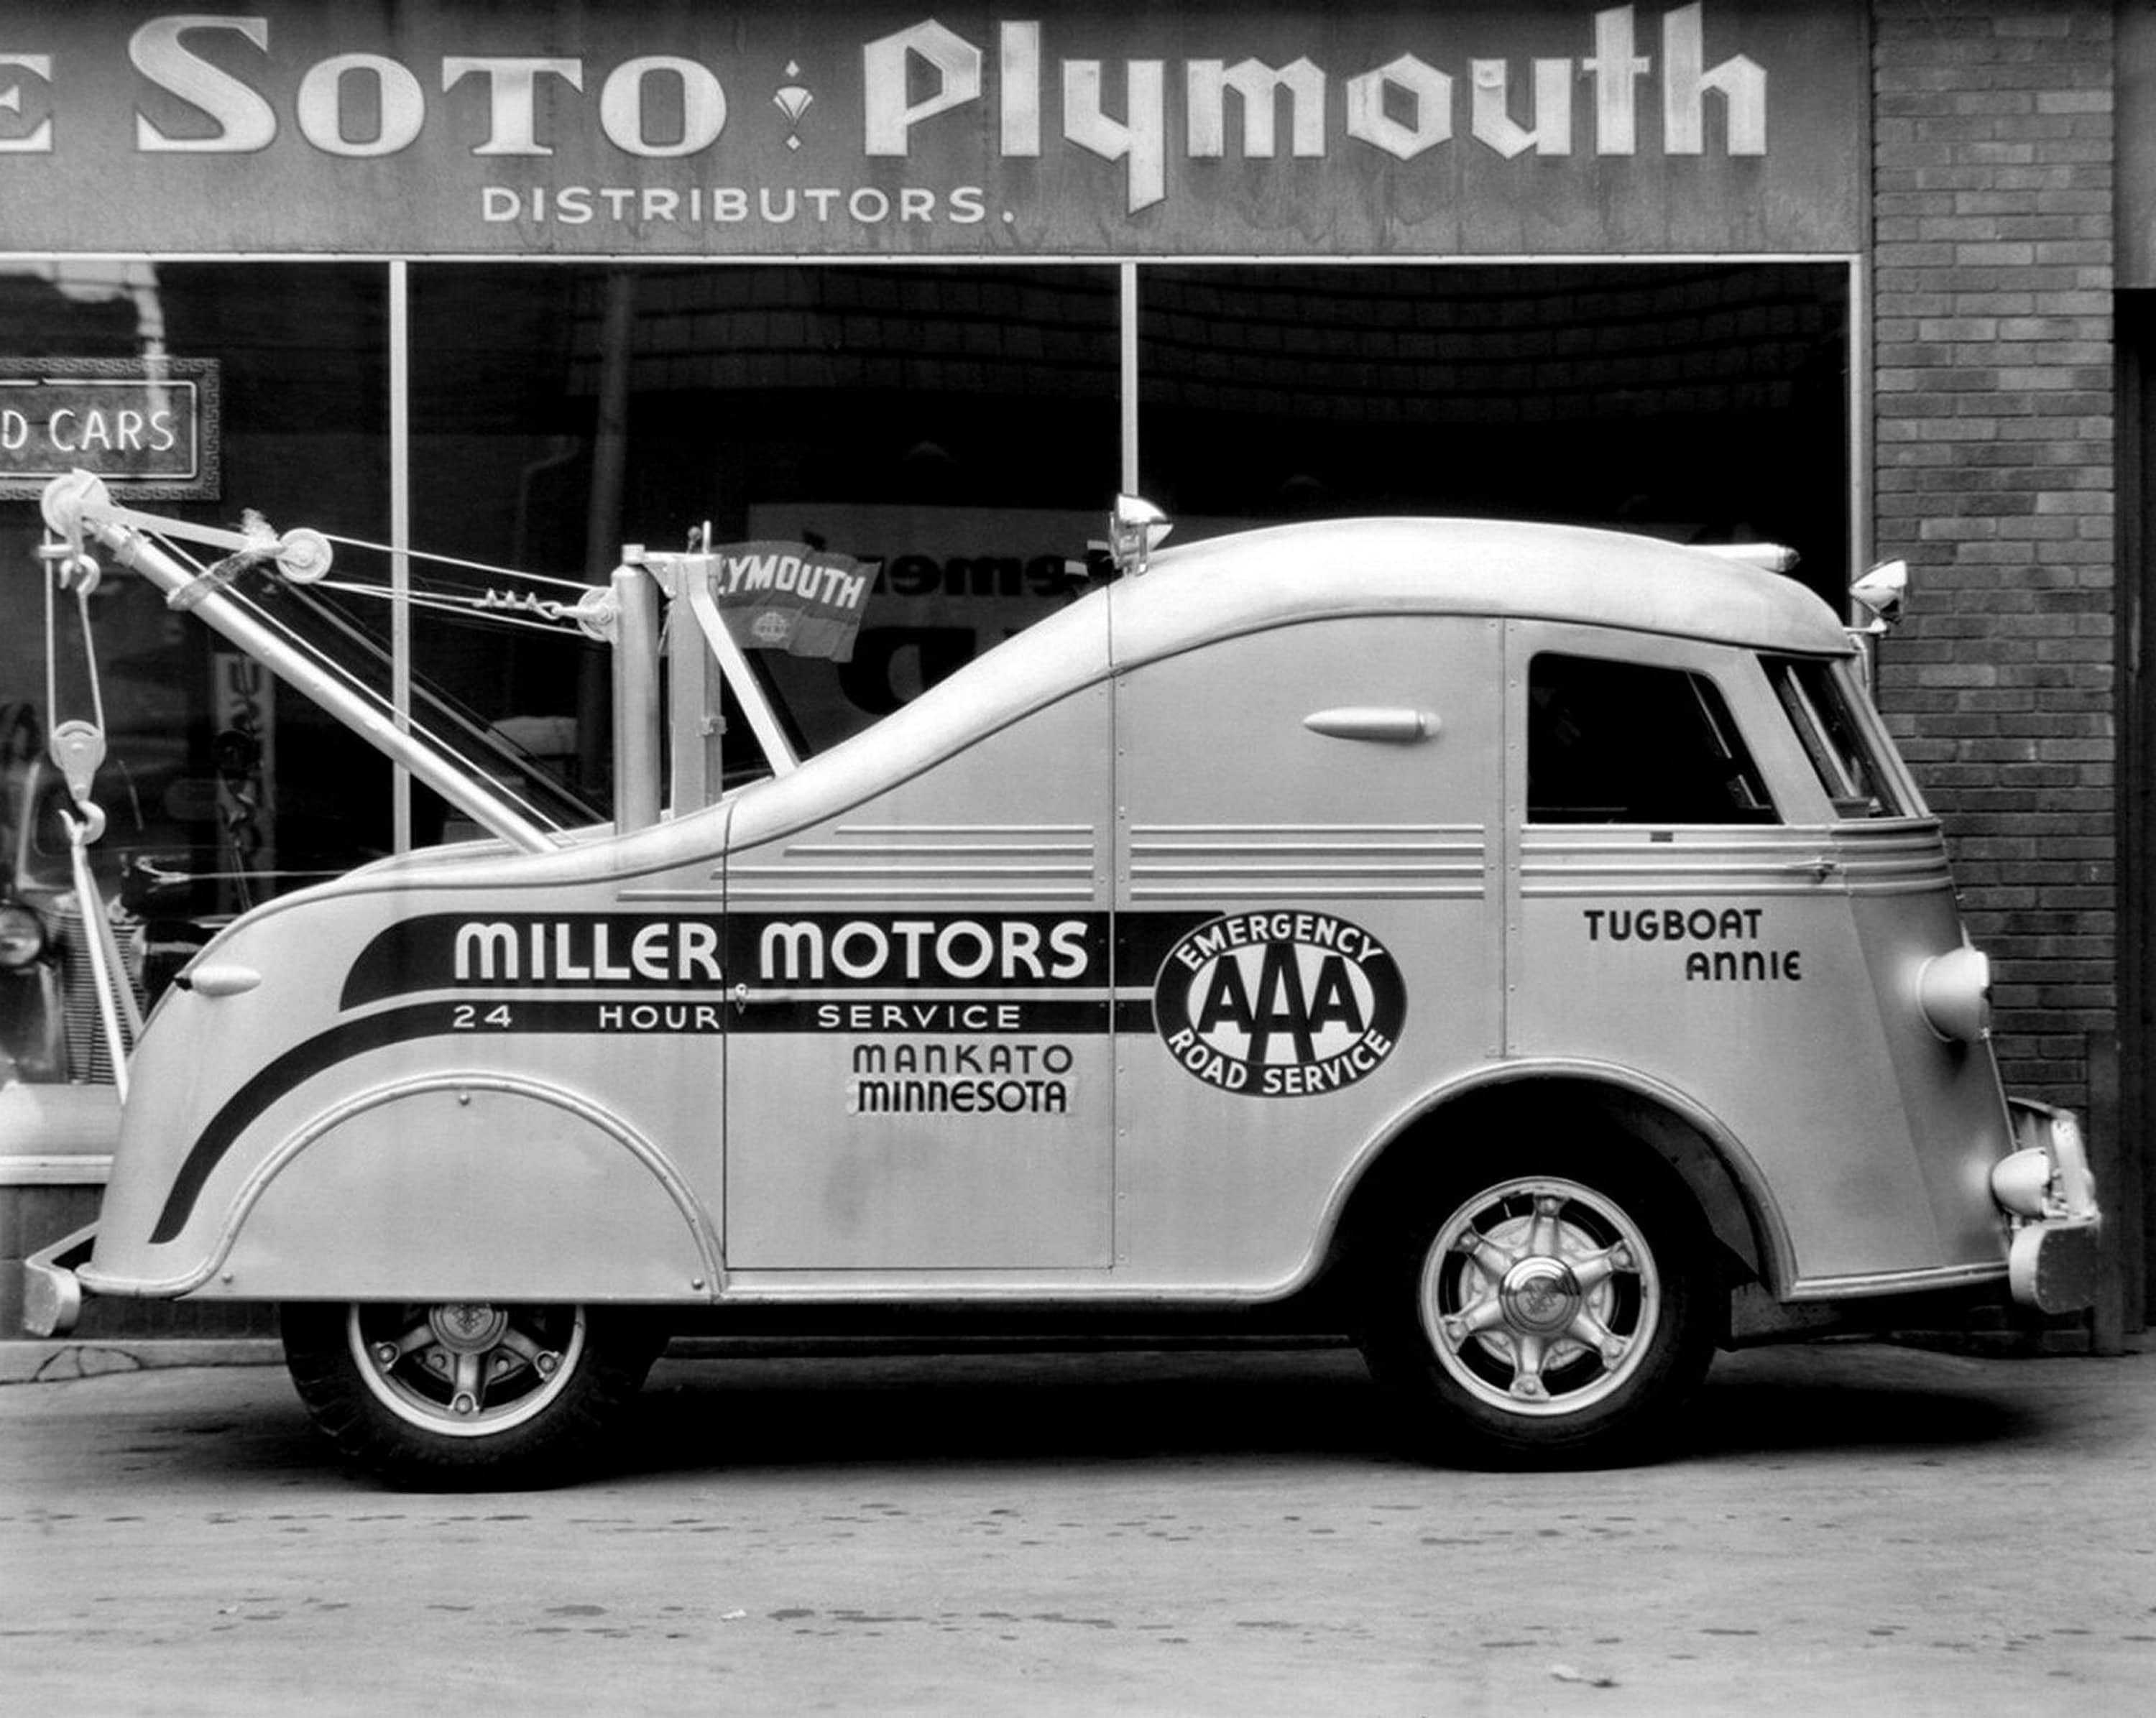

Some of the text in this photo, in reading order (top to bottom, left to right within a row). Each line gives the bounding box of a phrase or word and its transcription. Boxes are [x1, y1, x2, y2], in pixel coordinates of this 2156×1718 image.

[863, 1, 1768, 215] Plymouth
[482, 186, 1014, 224] DISTRIBUTORS.
[49, 409, 174, 451] CARS
[1175, 913, 1384, 971] EMERGENCY
[1583, 908, 1763, 941] TUGBOAT
[455, 921, 1088, 980] MILLER MOTORS
[1686, 950, 1802, 981] ANNIE
[453, 1004, 1021, 1029] 24 HOUR SERVICE
[1196, 943, 1364, 1065] AAA
[853, 1043, 1074, 1074] MANKATO
[1169, 1027, 1391, 1094] ROAD SERVICE
[858, 1080, 1067, 1113] MINNESOTA
